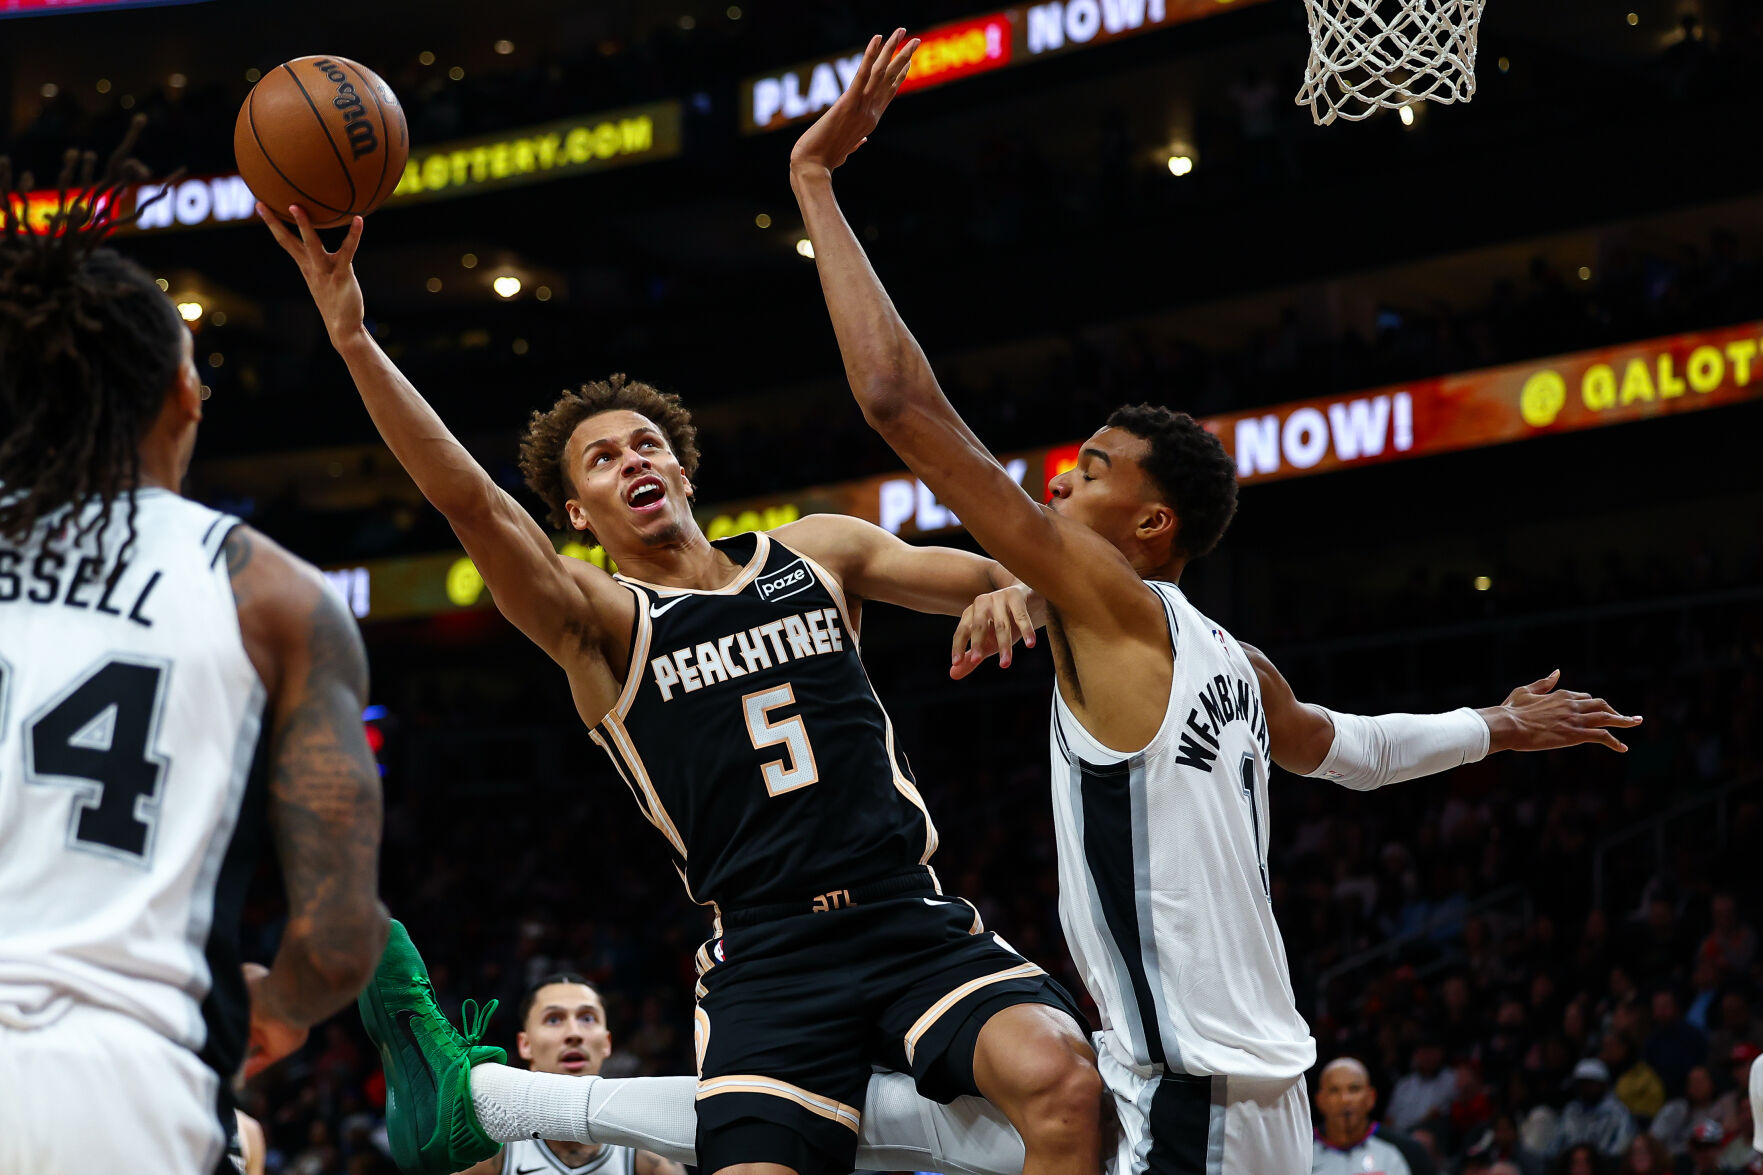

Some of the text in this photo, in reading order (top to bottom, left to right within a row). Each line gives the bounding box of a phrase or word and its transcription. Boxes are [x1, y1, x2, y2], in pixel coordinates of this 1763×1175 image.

[313, 59, 378, 162] Wilson
[394, 114, 653, 195] LOTTERY.COM
[1234, 390, 1414, 478] NOW!
[1581, 336, 1763, 422] GALOT
[762, 568, 806, 597] paze
[650, 607, 844, 703] PEACHTREE
[741, 682, 819, 798] 5
[812, 889, 858, 913] ATL
